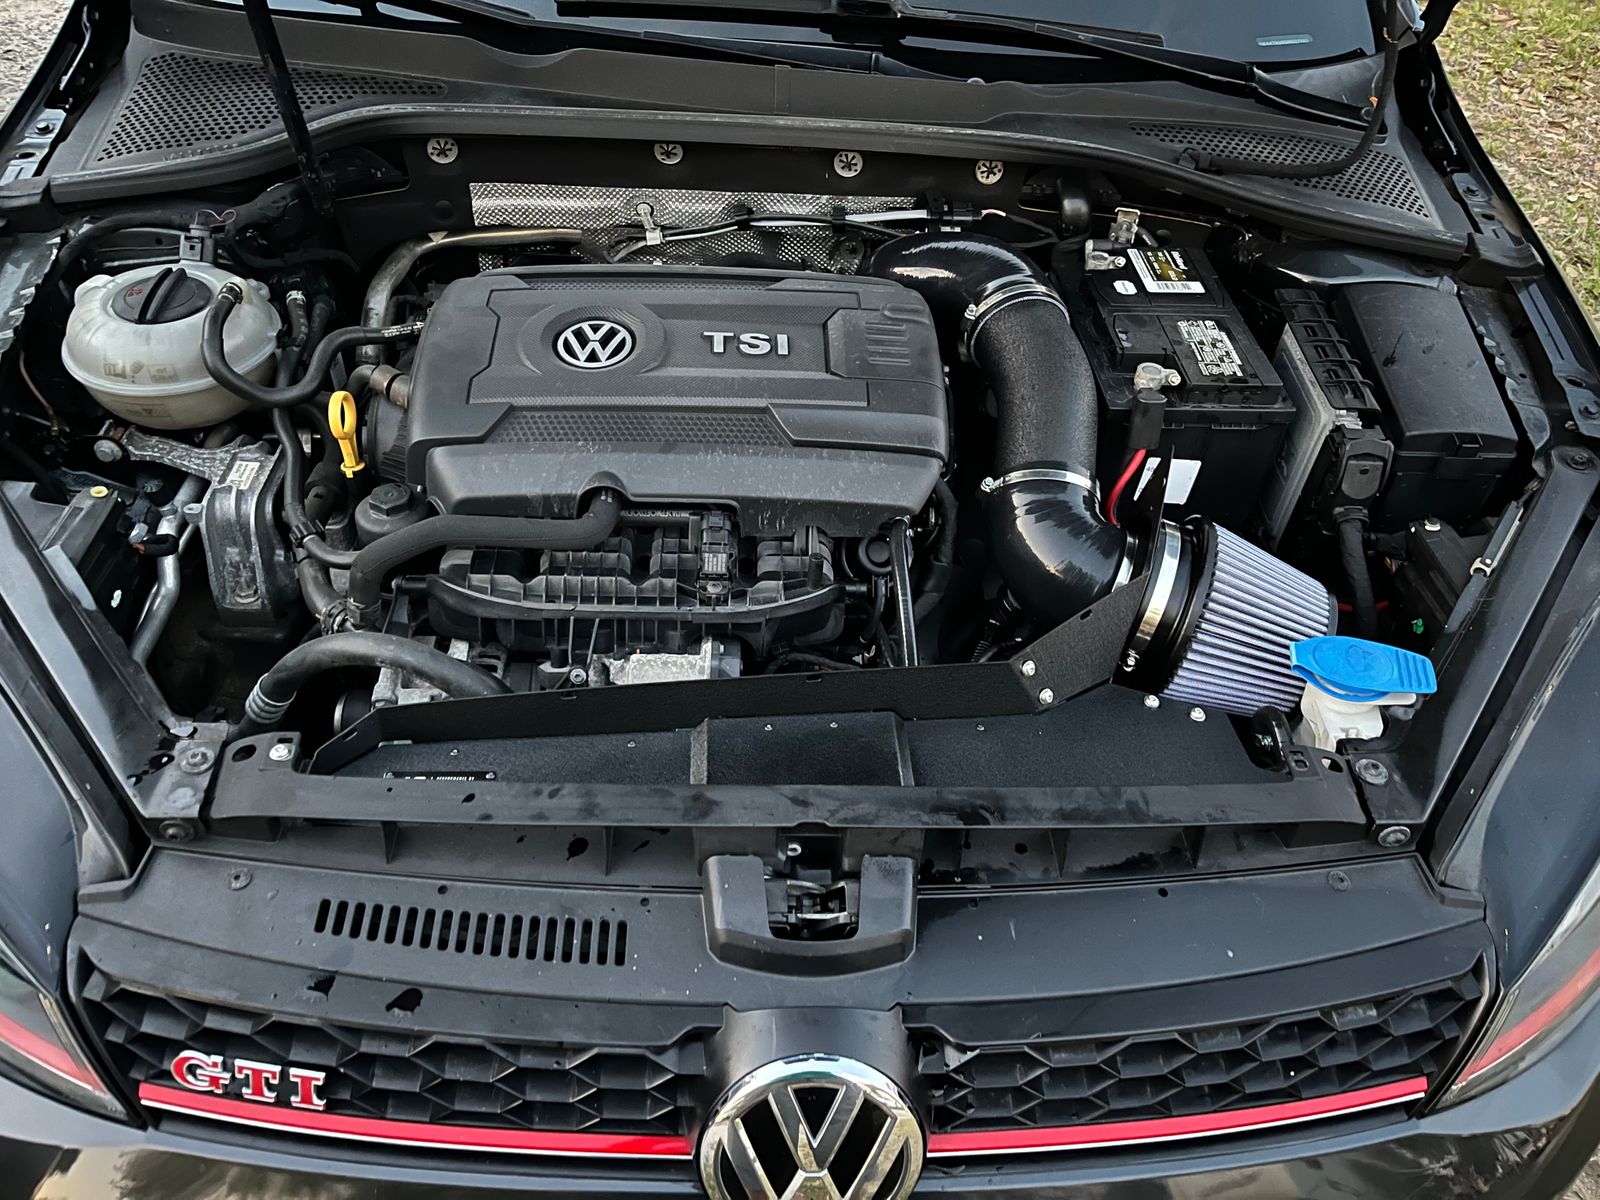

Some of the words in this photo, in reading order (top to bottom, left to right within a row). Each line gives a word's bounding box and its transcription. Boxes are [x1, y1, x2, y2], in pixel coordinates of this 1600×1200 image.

[556, 320, 632, 367] VW
[703, 331, 790, 356] TSI
[170, 1050, 327, 1111] GTI
[705, 1064, 918, 1200] VW
